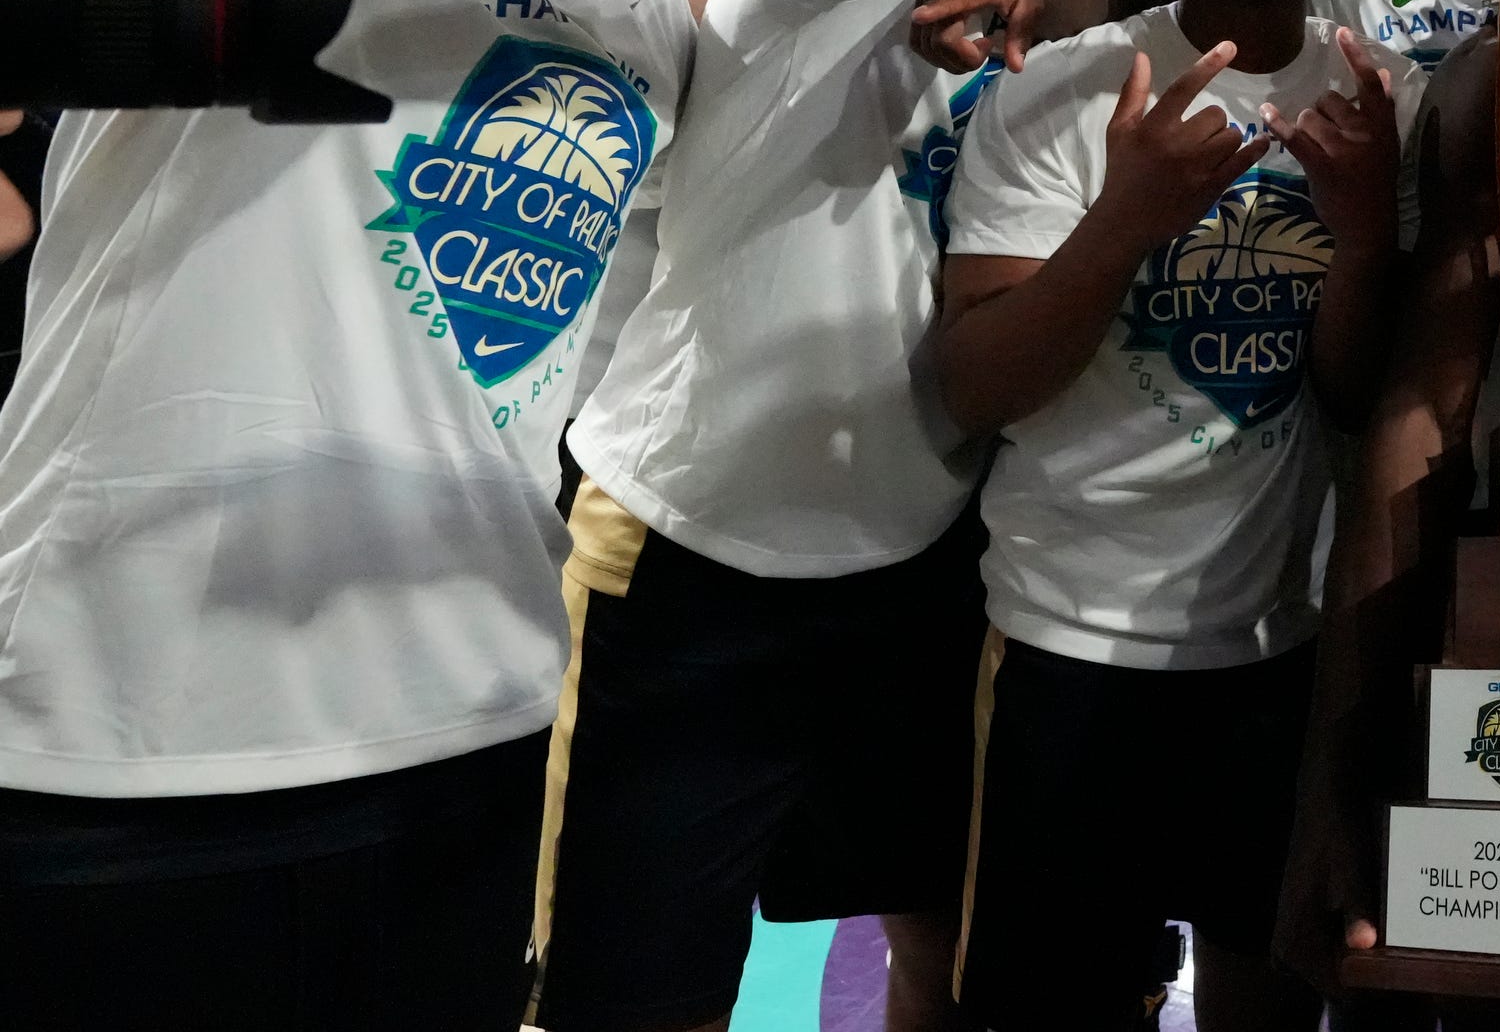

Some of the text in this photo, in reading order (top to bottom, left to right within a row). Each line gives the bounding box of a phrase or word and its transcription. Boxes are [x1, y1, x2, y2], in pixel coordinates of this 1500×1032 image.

[408, 157, 518, 212] CITY
[516, 181, 573, 230] OF
[379, 238, 450, 339] 2025
[429, 230, 584, 317] CLASSIC
[1147, 278, 1324, 322] CITY OF PA
[1189, 329, 1304, 375] CLASSI
[1127, 355, 1182, 424] 2025
[1474, 738, 1498, 753] CITY
[1419, 866, 1464, 889] "BILL
